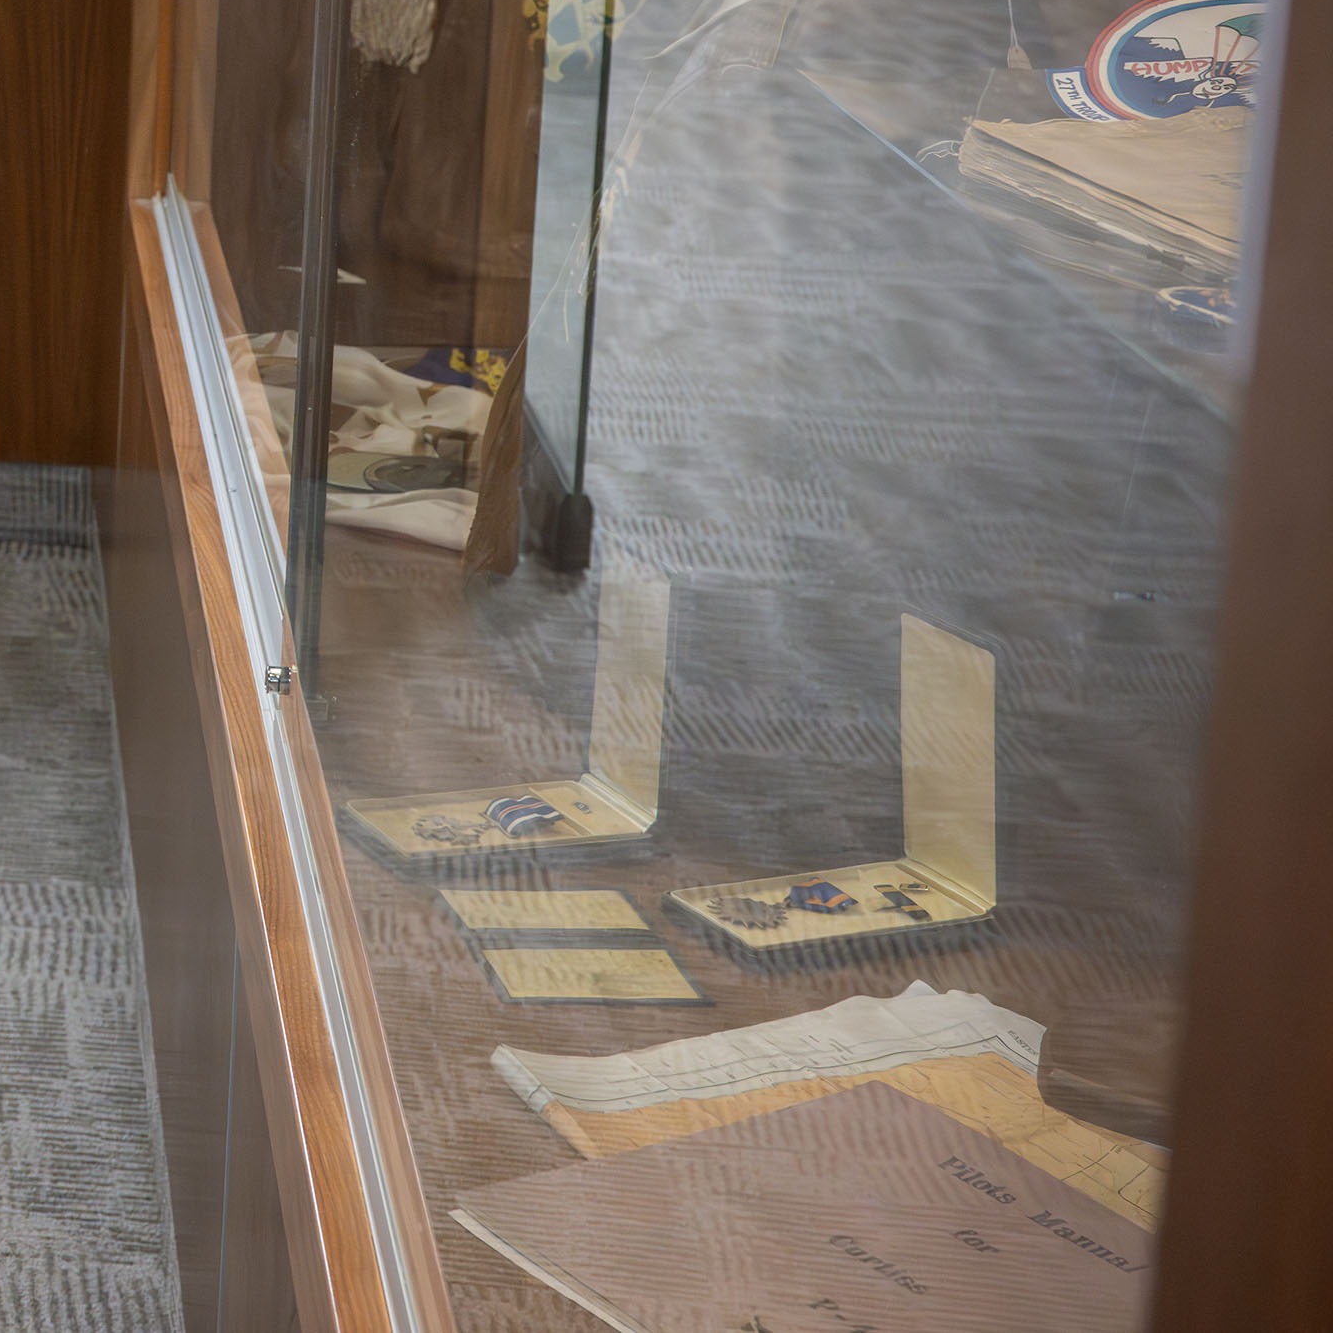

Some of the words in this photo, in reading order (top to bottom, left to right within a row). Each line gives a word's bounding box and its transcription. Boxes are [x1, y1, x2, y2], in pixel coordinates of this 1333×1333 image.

[1131, 59, 1209, 75] HUMP
[1055, 77, 1082, 101] 27TH
[936, 1155, 1017, 1205] Pilots
[952, 1228, 1000, 1254] for
